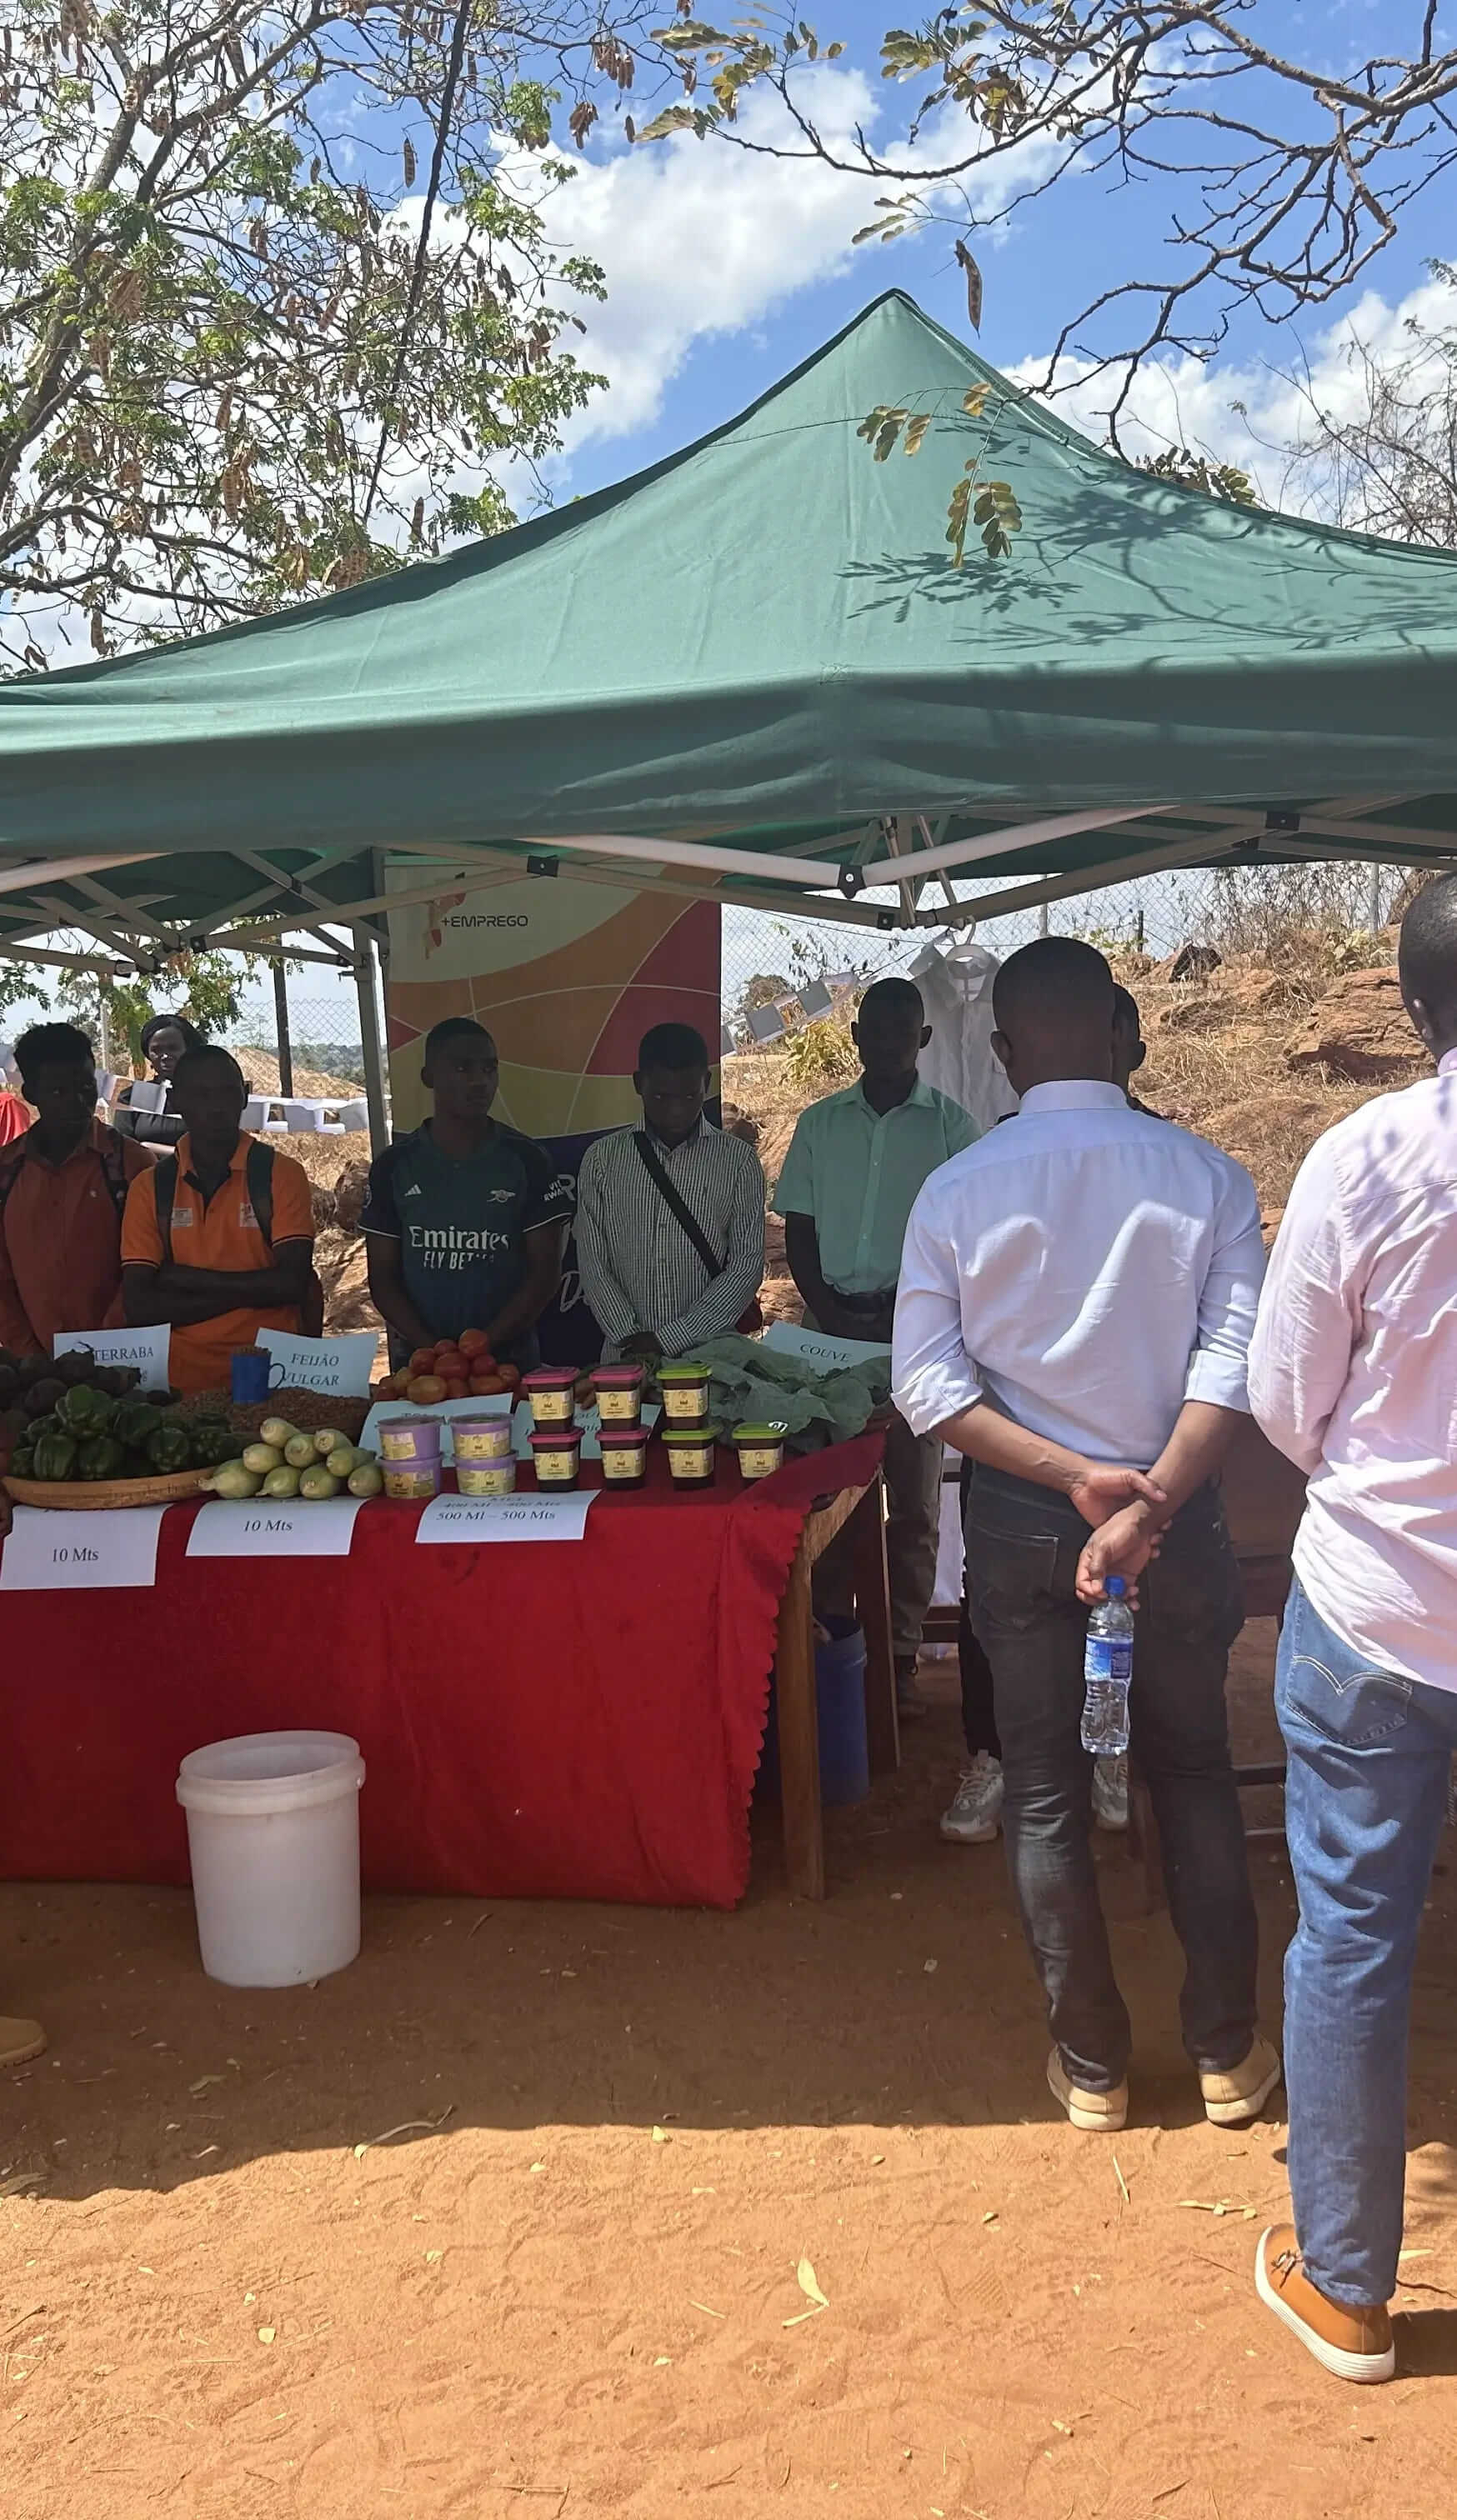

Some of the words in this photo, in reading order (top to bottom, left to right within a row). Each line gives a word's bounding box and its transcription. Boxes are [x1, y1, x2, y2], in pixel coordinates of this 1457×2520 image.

[441, 915, 528, 928] +EMPREGO
[408, 1225, 509, 1251] Emirates
[423, 1251, 445, 1269] FLY
[449, 1251, 494, 1270] BET
[93, 1346, 154, 1362] TERRABA
[291, 1352, 340, 1368] FEIJÃO
[800, 1343, 849, 1362] COUVE
[436, 1512, 462, 1521] 500
[500, 1511, 525, 1521] 500
[529, 1510, 555, 1520] Mts
[243, 1520, 260, 1532] 10
[265, 1519, 293, 1532] Mts
[53, 1548, 68, 1562] 10
[73, 1547, 99, 1562] Mts
